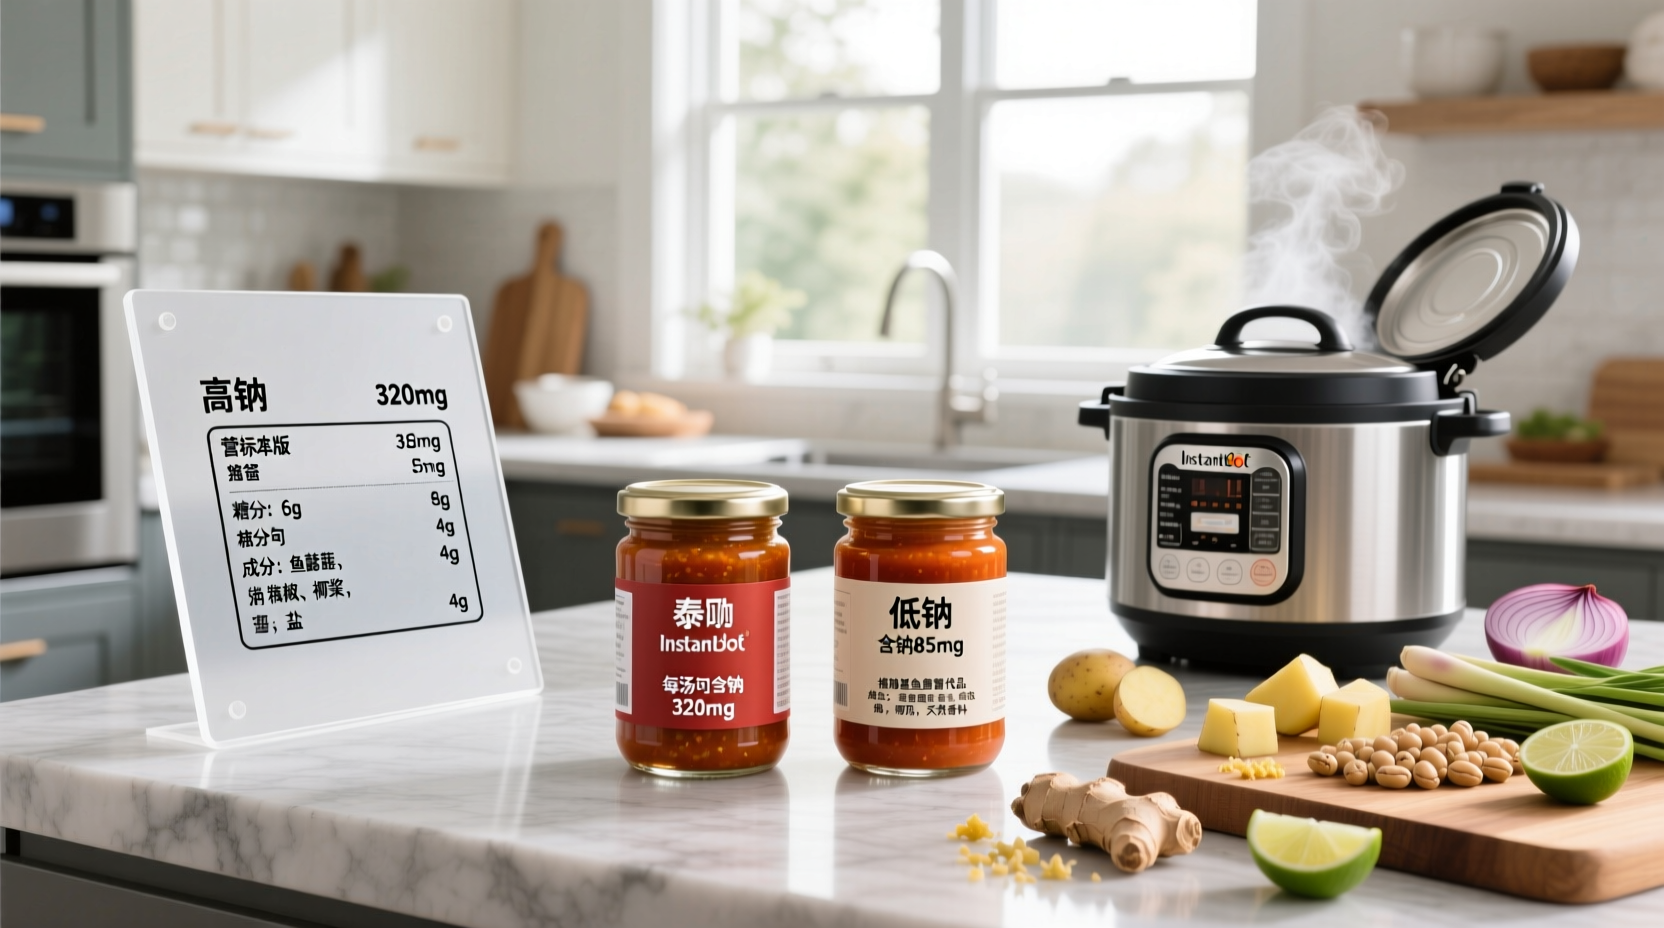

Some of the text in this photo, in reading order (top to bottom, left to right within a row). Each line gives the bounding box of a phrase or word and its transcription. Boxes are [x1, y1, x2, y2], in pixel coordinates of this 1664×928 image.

[199, 376, 268, 414] 高钠
[375, 383, 448, 411] 320mg
[395, 432, 441, 453] 38mg
[411, 457, 446, 478] 5mg
[435, 517, 456, 538] 4g
[439, 544, 460, 565] 4g
[448, 593, 469, 613] 4g
[888, 595, 952, 630] 低钠
[877, 634, 964, 657] 含钠85mg
[672, 698, 735, 722] 320mg
